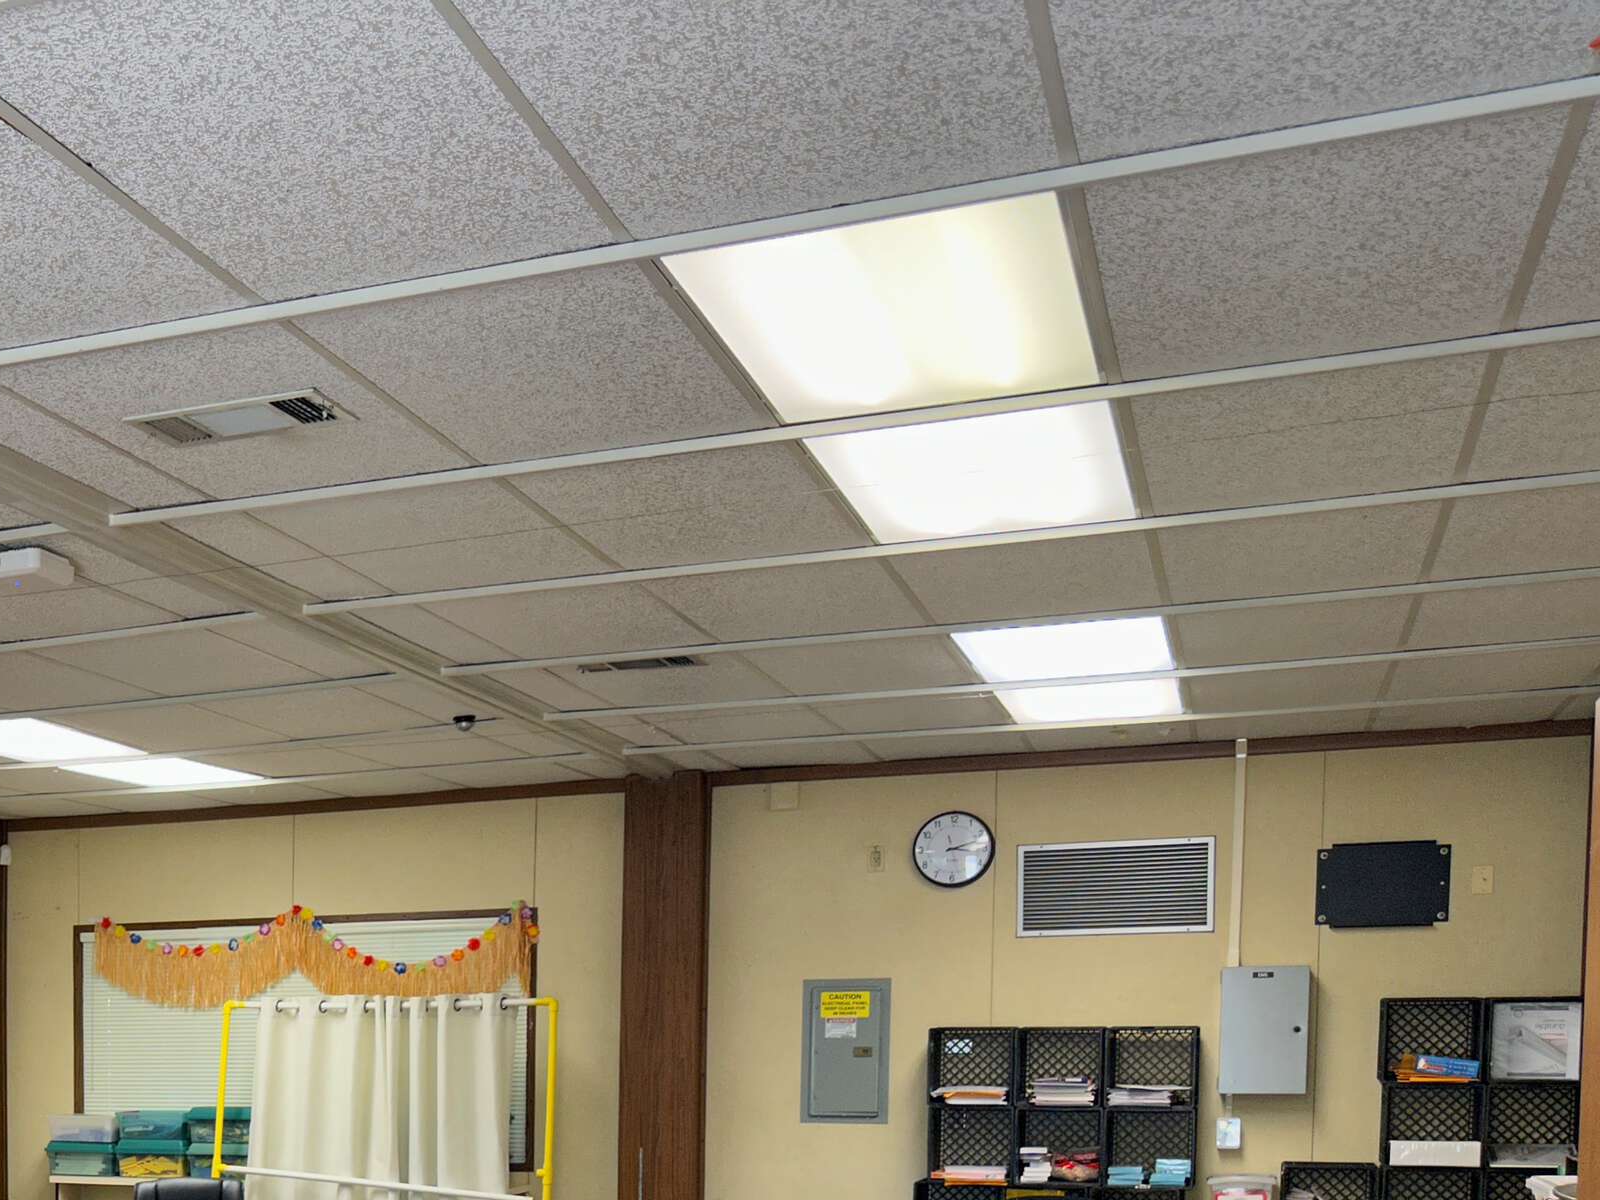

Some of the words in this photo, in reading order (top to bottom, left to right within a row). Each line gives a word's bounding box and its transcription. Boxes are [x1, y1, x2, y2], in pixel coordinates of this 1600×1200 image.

[950, 815, 959, 823] 12
[934, 820, 941, 828] 11
[923, 831, 931, 839] 10
[922, 860, 928, 869] 8
[949, 874, 955, 882] 6
